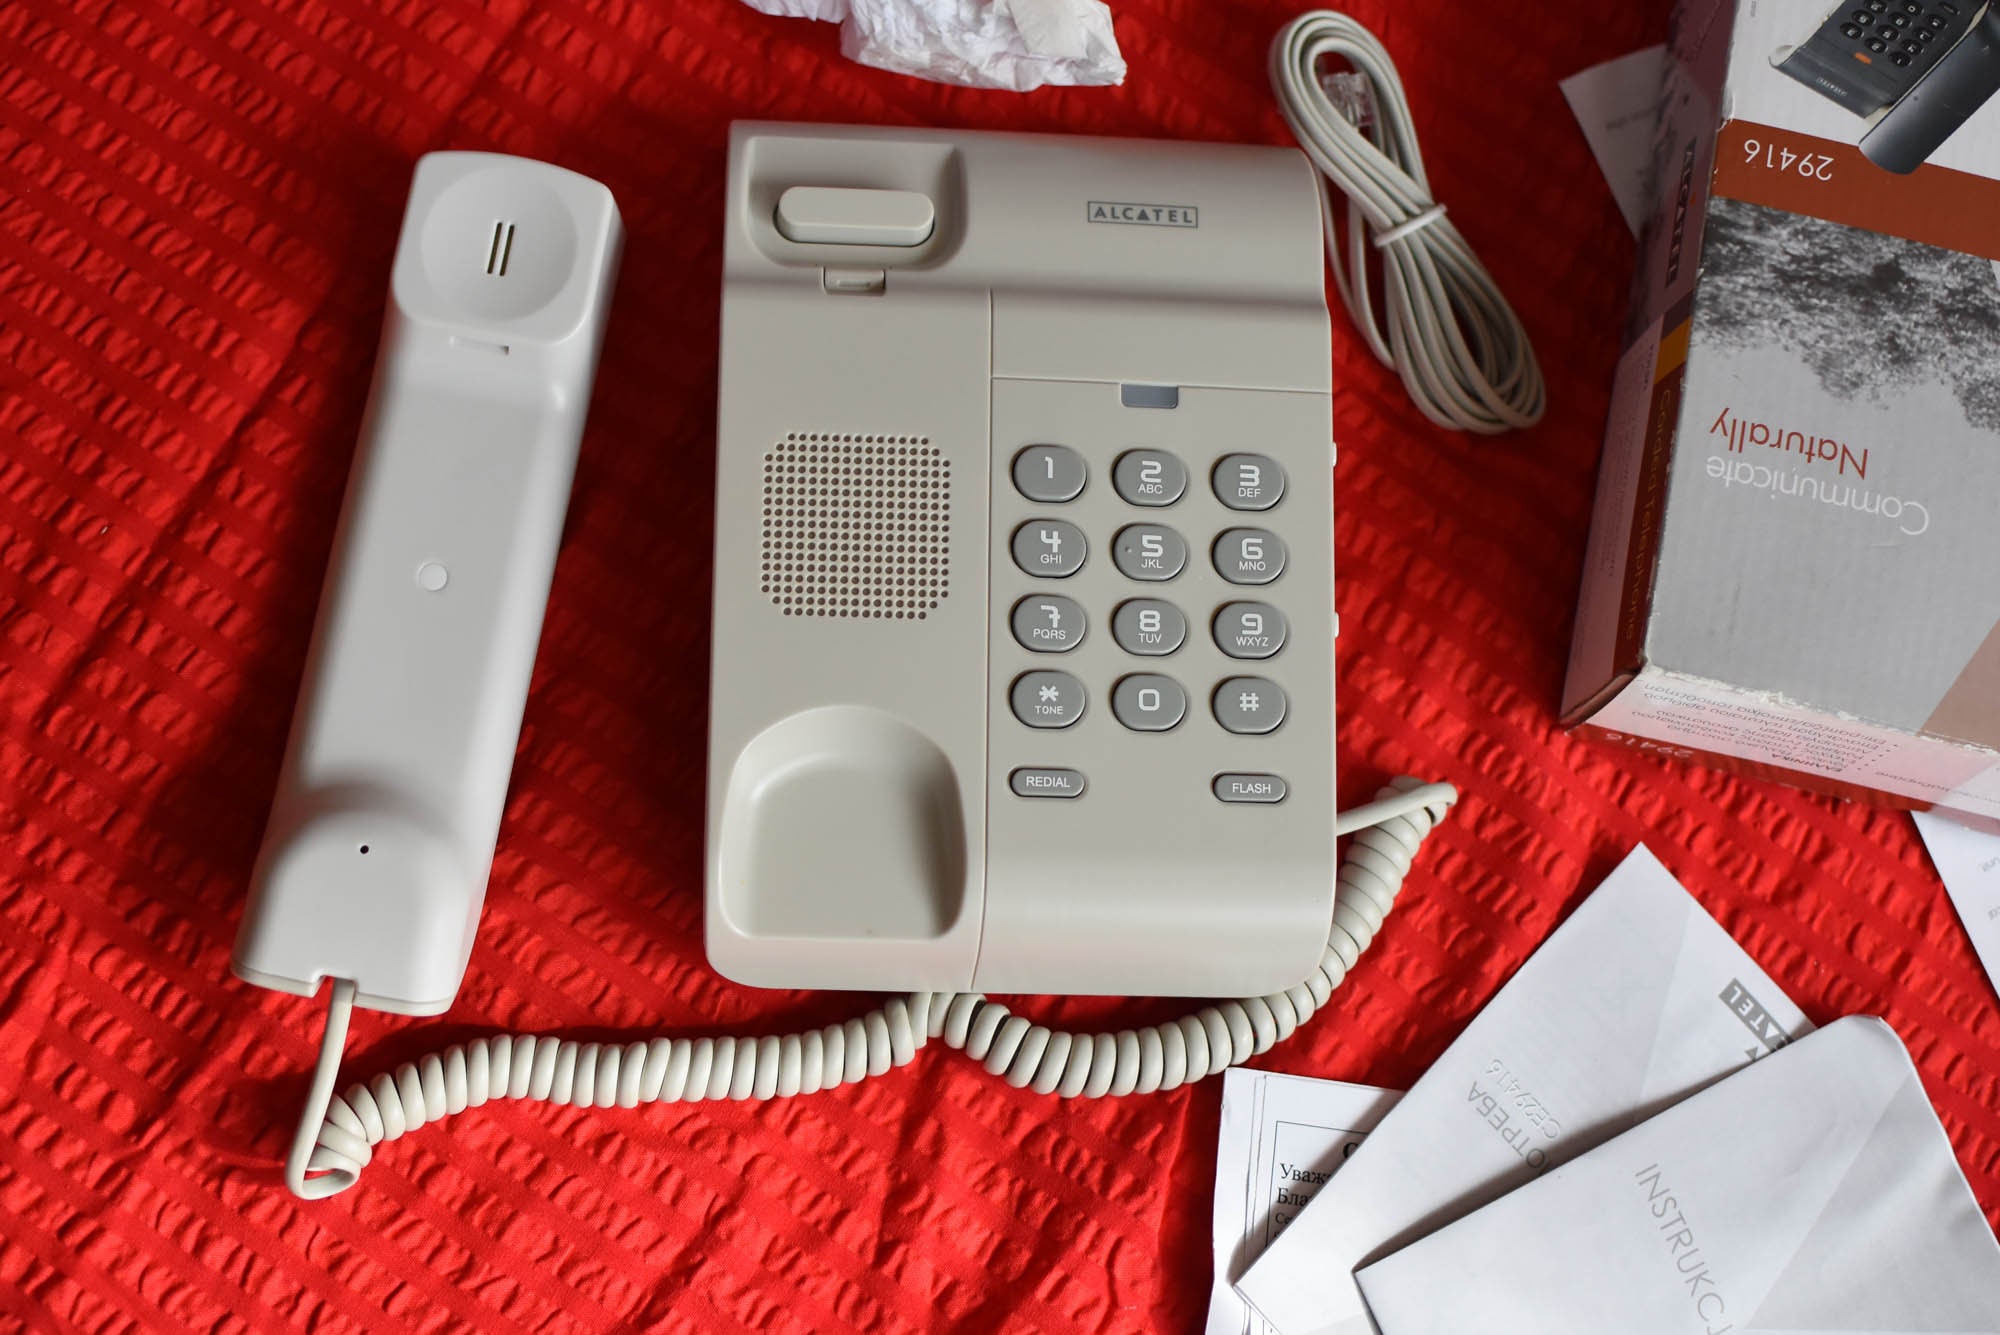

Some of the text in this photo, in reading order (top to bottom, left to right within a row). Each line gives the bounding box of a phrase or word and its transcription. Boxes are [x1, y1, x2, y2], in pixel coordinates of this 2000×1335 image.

[1743, 139, 1835, 181] 29416
[1094, 206, 1193, 224] ALCATEL
[1710, 408, 1869, 480] Naturally
[1044, 456, 1054, 479] 1
[1140, 460, 1162, 483] 2
[1239, 464, 1261, 487] 3
[1138, 484, 1164, 495] ABC
[1238, 487, 1262, 498] DEF
[1706, 456, 1930, 535] Communicate
[1040, 530, 1062, 553] 4
[1141, 535, 1163, 557] 5
[1241, 537, 1263, 560] 6
[1040, 553, 1062, 565] GHI
[1141, 558, 1164, 570] JKL
[1238, 561, 1267, 572] MNO
[1040, 605, 1061, 629] 7
[1139, 610, 1161, 632] 8
[1241, 613, 1263, 635] 9
[1033, 628, 1066, 640] PQRS
[1138, 633, 1162, 644] TUV
[1235, 636, 1269, 648] WXYZ
[1034, 705, 1064, 715] TONE
[1138, 688, 1160, 711] 0
[1026, 776, 1071, 789] REDIAL
[1232, 782, 1272, 795] FLASH
[1729, 985, 1788, 1047] ATEL
[1280, 1163, 1332, 1185] Уваж
